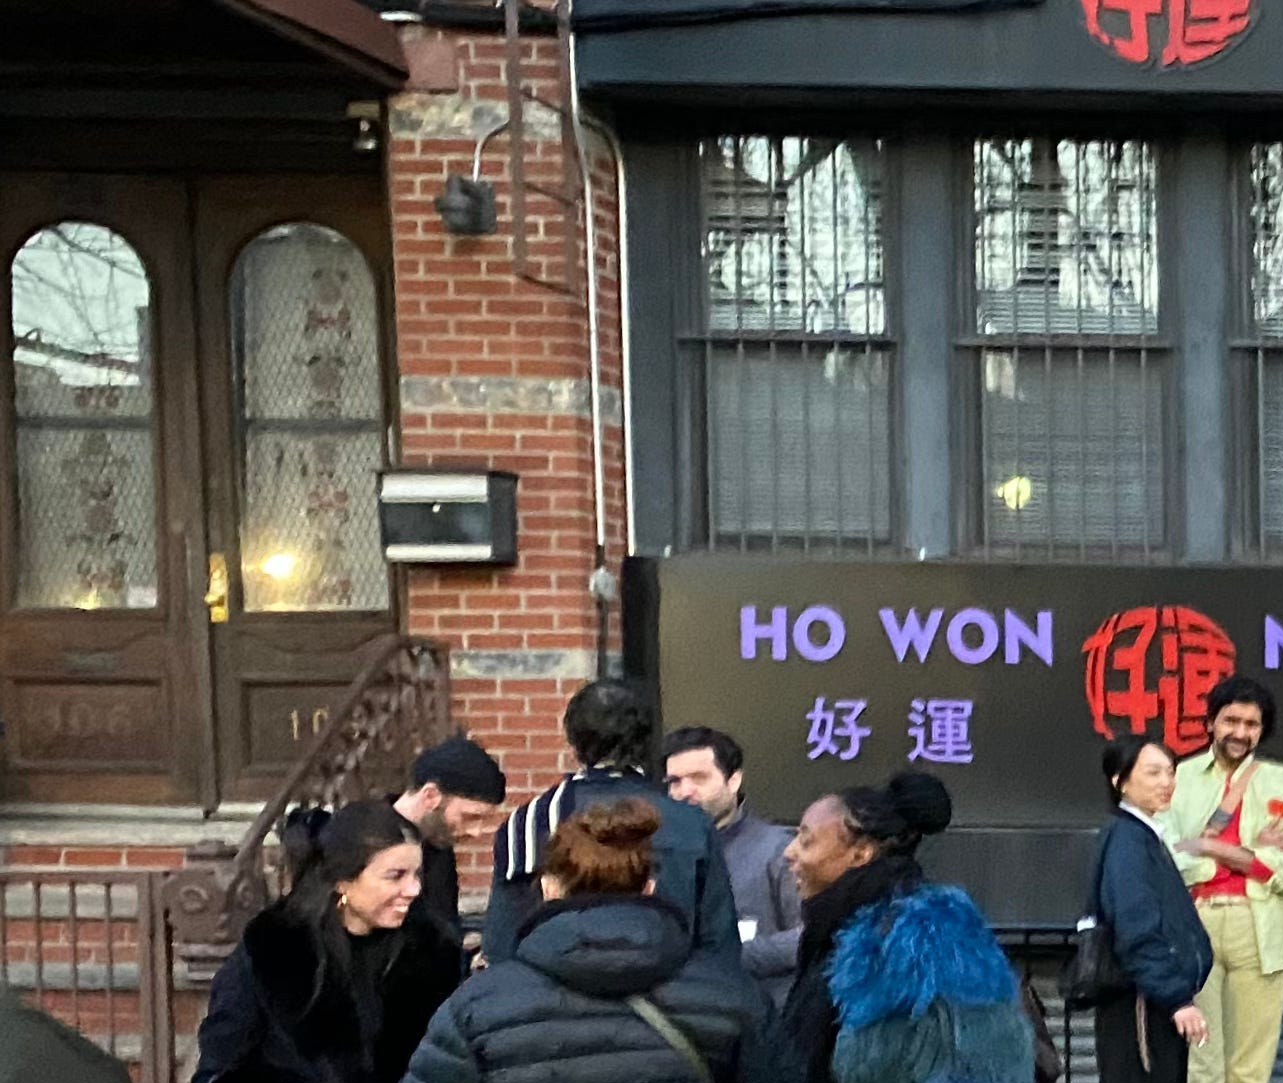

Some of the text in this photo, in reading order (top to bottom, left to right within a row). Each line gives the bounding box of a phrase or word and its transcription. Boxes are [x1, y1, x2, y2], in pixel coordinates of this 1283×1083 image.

[738, 605, 848, 664] HO
[878, 607, 1055, 667] WON
[805, 696, 974, 763] 好運
